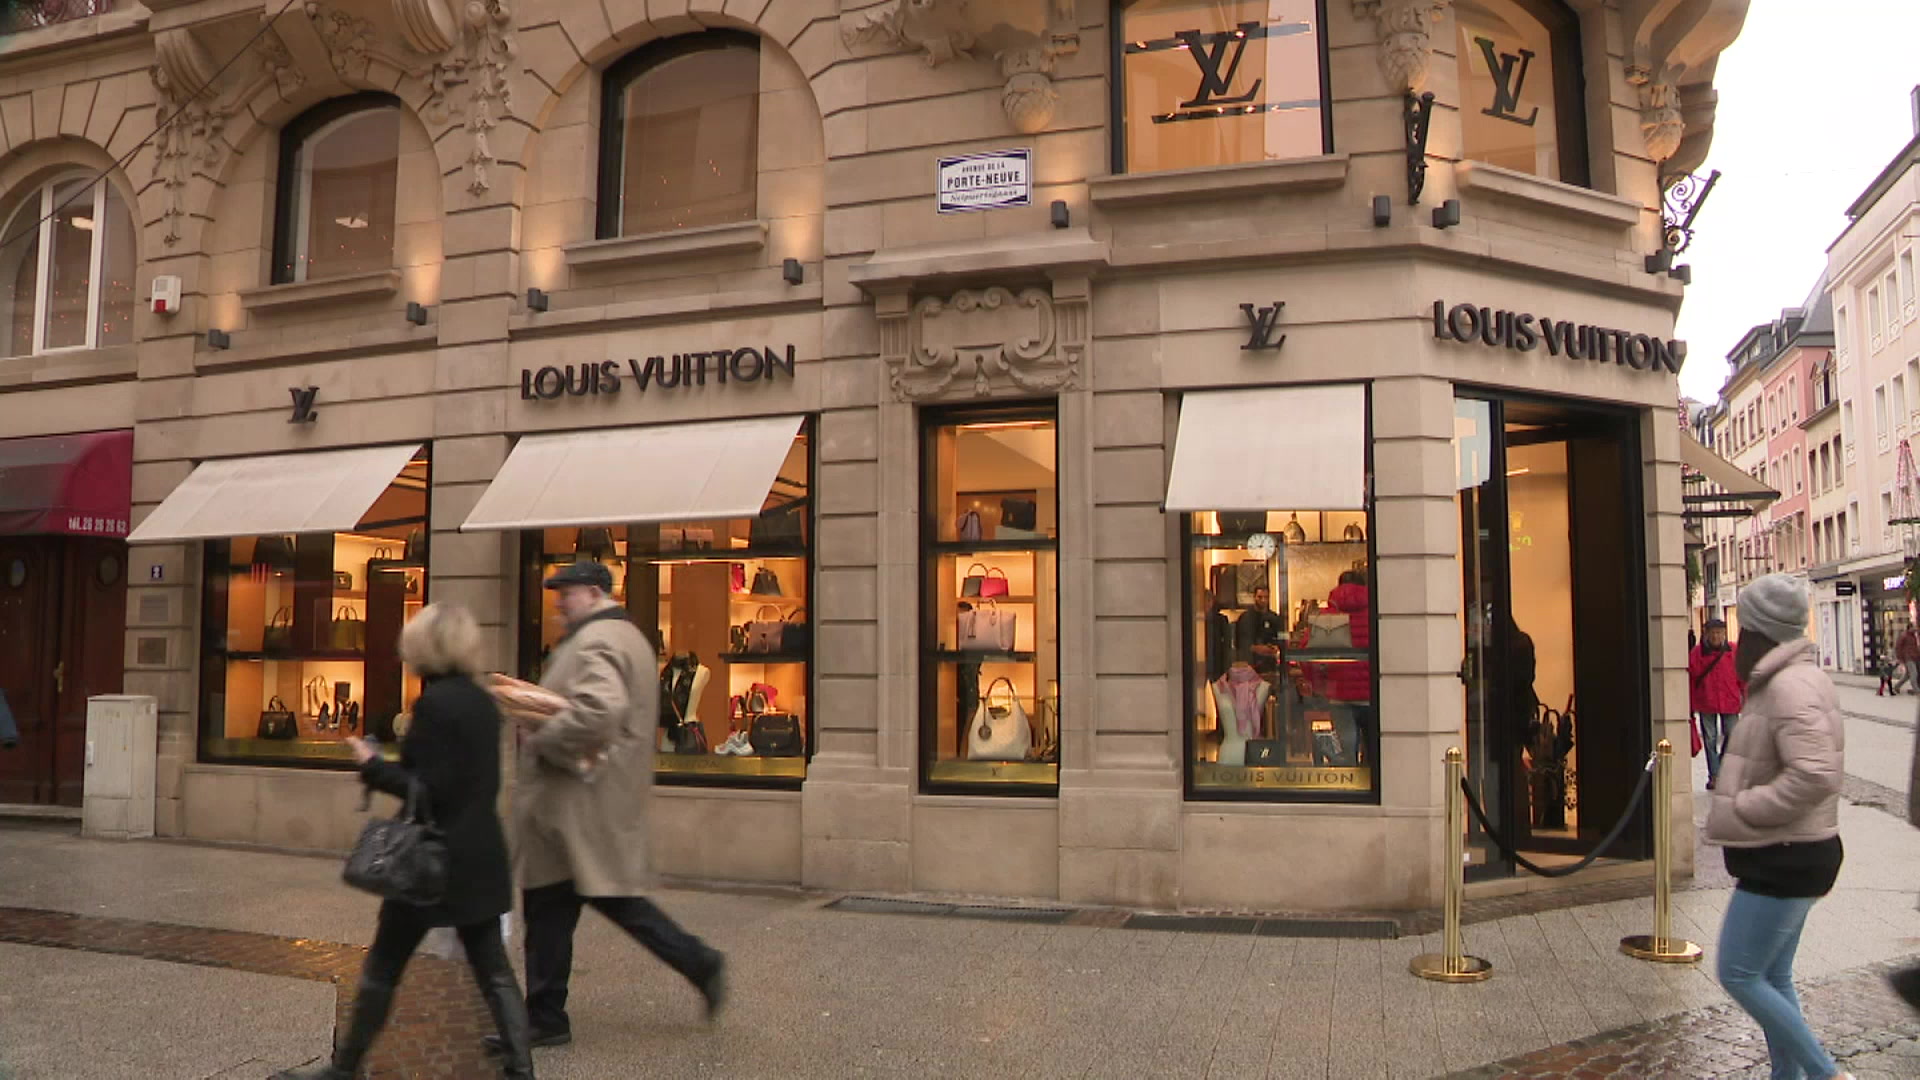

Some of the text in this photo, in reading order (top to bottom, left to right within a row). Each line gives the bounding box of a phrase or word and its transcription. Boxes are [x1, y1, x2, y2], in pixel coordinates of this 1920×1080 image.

[987, 162, 995, 170] DE
[997, 161, 1005, 169] LA
[947, 171, 1020, 188] PORTE-NEUVE
[1433, 299, 1687, 374] LOUIS VUITTON
[521, 344, 796, 401] LOUIS VUITTON
[1212, 771, 1354, 784] LOUIS VUITTON
